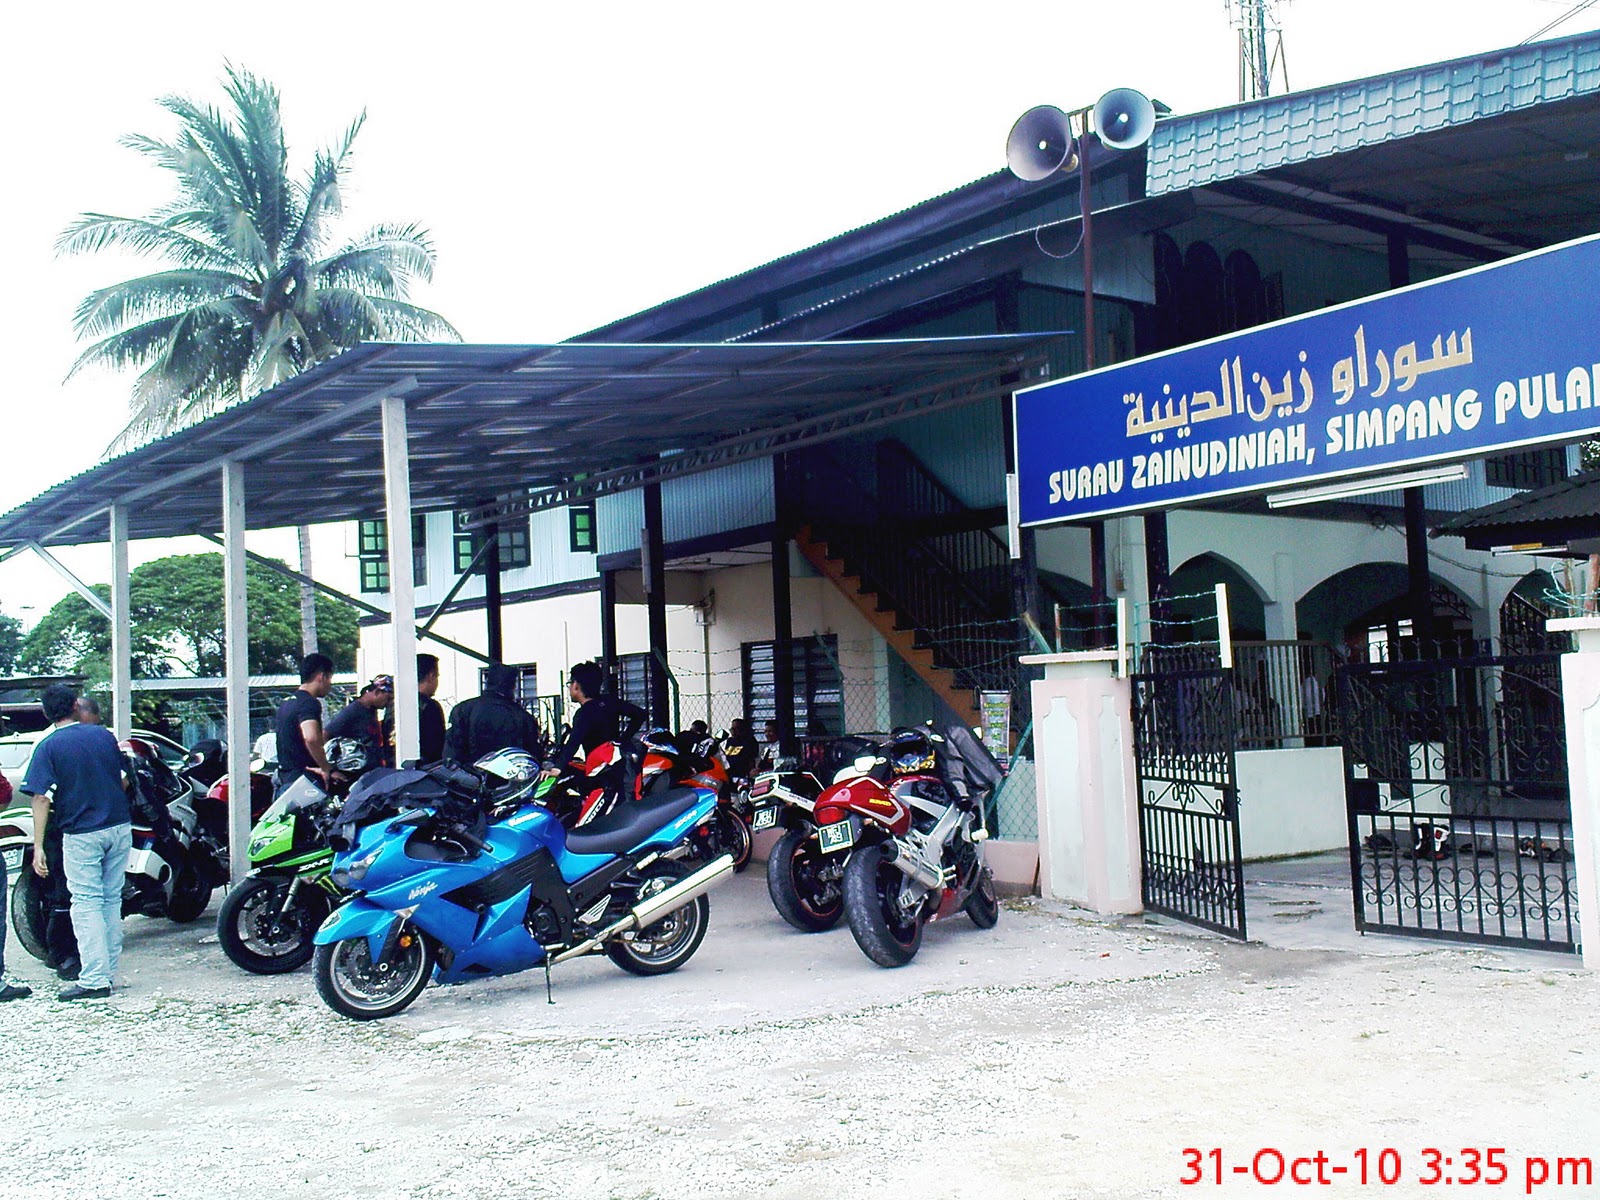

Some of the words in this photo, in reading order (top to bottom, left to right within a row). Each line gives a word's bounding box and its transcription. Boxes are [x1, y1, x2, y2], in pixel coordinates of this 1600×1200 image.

[1332, 324, 1473, 405] سوراو
[1048, 458, 1124, 504] SURAU
[1131, 423, 1316, 489] ZAINUDINIAH,
[1325, 388, 1483, 456] SIMPANG
[407, 880, 438, 901] Ninja
